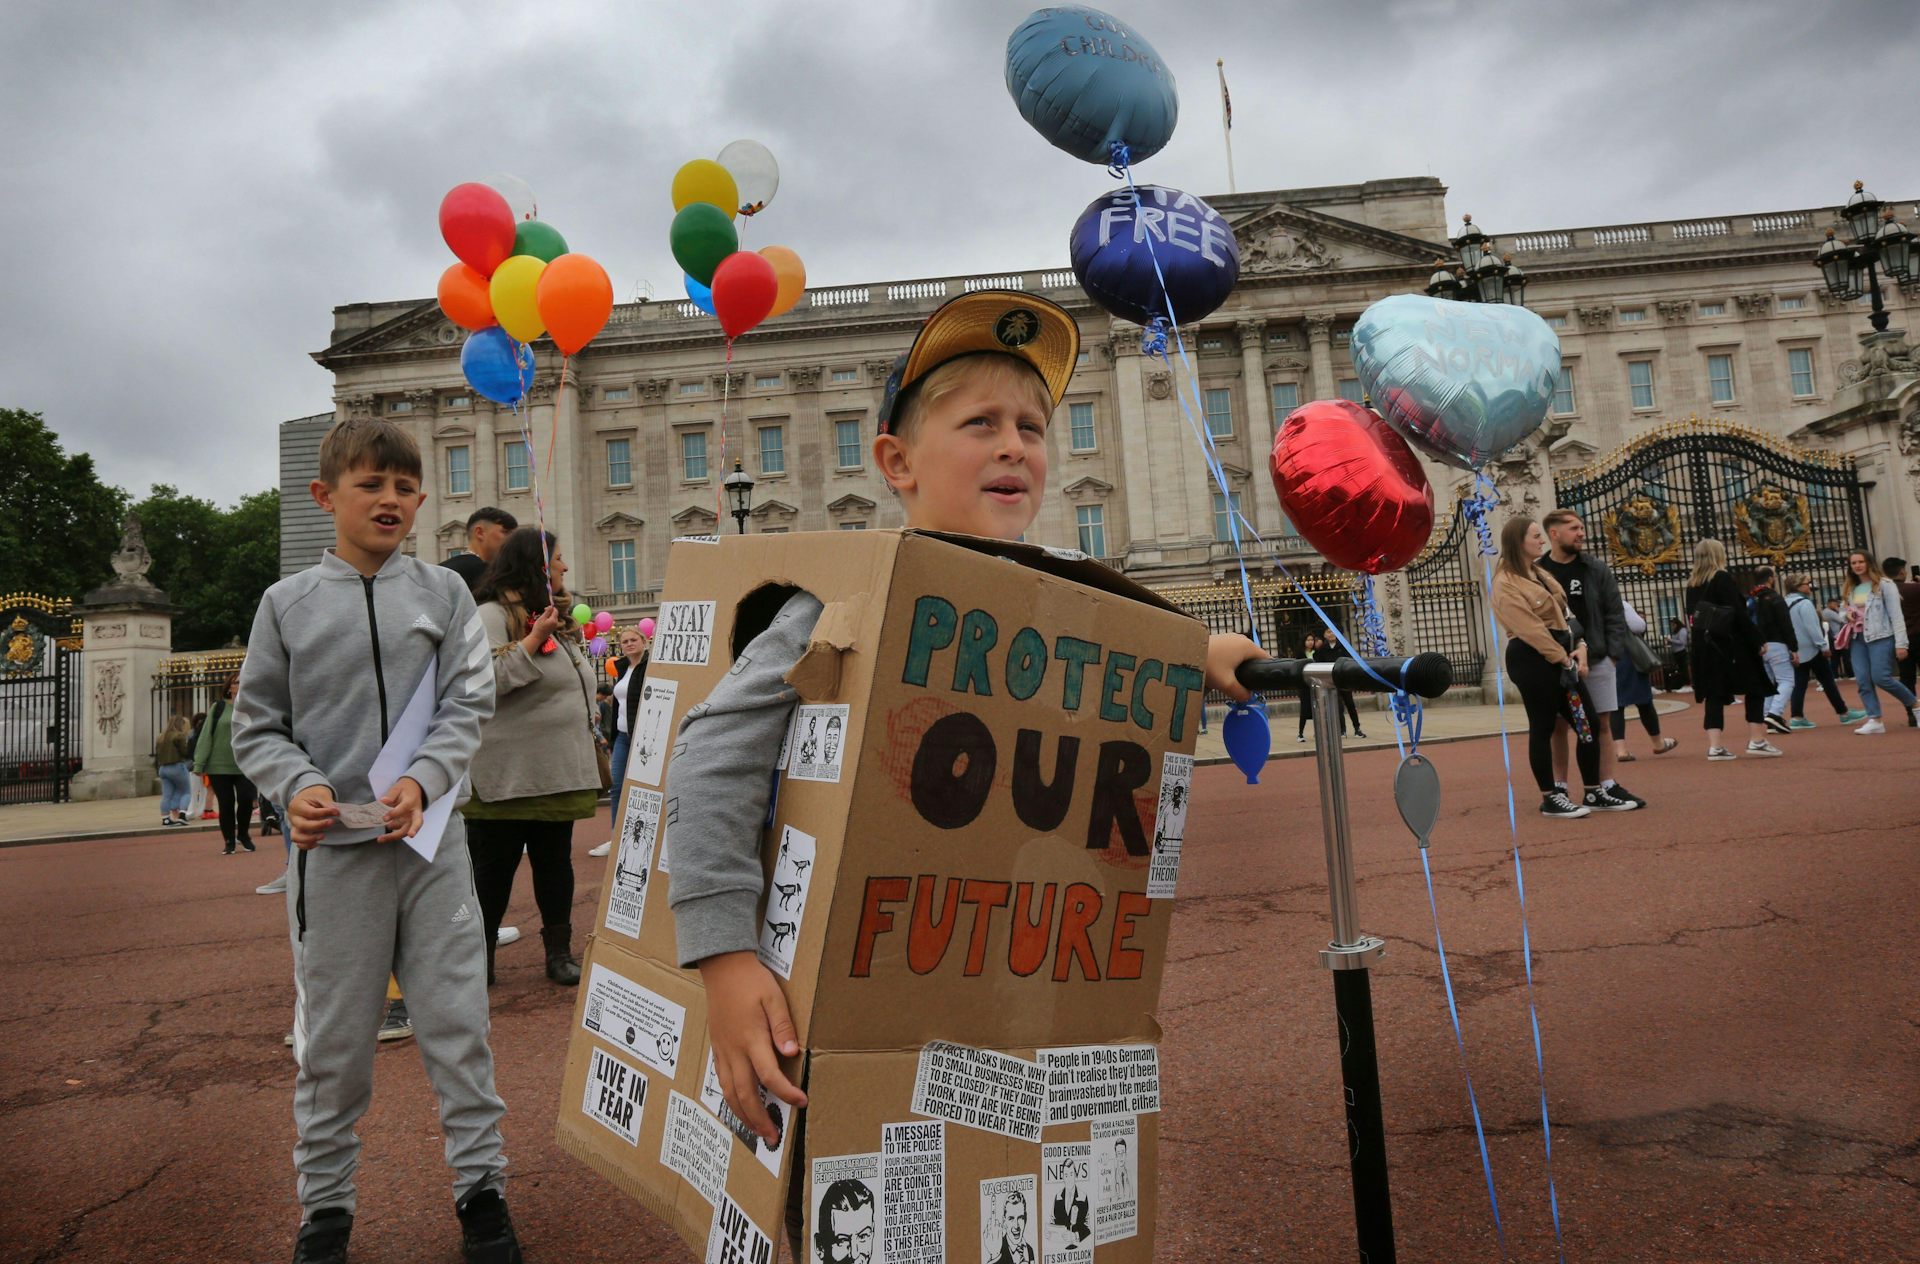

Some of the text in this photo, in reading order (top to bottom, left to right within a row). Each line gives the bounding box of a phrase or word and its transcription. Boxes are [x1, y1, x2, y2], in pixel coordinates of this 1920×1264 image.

[1099, 206, 1228, 268] FREE
[668, 605, 710, 632] STAY
[659, 634, 709, 663] FREE
[901, 594, 1204, 742] PROTECT
[1164, 764, 1187, 776] CALLING
[910, 711, 1151, 857] OUR
[629, 797, 660, 814] CALLING YOU
[1152, 856, 1156, 865] A
[617, 889, 643, 904] CONSPIRACY
[611, 898, 642, 920] THEORIST
[849, 874, 1152, 982] FUTURE
[943, 1043, 965, 1059] FACE
[967, 1049, 997, 1068] MASKS
[1028, 1066, 1046, 1082] WHY
[1047, 1047, 1155, 1069] People in 1940s Germany
[597, 1054, 626, 1093] LIVE
[629, 1074, 646, 1106] IN
[932, 1054, 1044, 1096] DO SMALL BUSINESSES NEED
[1049, 1063, 1157, 1086] didn't realise they'd been
[930, 1068, 1043, 1109] TO BE CLOSED? IF THEY DON'T
[1049, 1079, 1158, 1103] brainwashed by the media
[599, 1086, 633, 1131] FEAR
[959, 1091, 980, 1108] WHY
[981, 1098, 998, 1113] ARE
[1000, 1102, 1014, 1116] WE
[1016, 1106, 1041, 1123] BEING
[1050, 1104, 1069, 1121] and
[678, 1098, 691, 1116] The
[720, 1134, 730, 1152] you
[924, 1098, 1040, 1139] FORCED TO WEAR THEM?
[1101, 1121, 1112, 1129] WEAR
[674, 1127, 685, 1143] the
[885, 1124, 942, 1142] A MESSAGE
[885, 1139, 942, 1155] TO THE POLICE:
[1044, 1145, 1091, 1158] GOOD EVENING
[901, 1154, 929, 1166] CHILDREN
[884, 1163, 942, 1178] GRANDCHILDREN
[885, 1174, 942, 1192] ARE GOING TO
[982, 1178, 1033, 1196] VACCINATE
[884, 1187, 942, 1204] HAVE TO LIVE IN
[885, 1199, 942, 1216] THE WORLD THAT
[885, 1210, 942, 1226] YOU ARE POLICING
[720, 1196, 749, 1252] LIVE
[750, 1230, 770, 1264] IN
[884, 1226, 901, 1239] INTO
[884, 1232, 942, 1252] IS THIS REALLY
[1057, 1252, 1067, 1263] SIX
